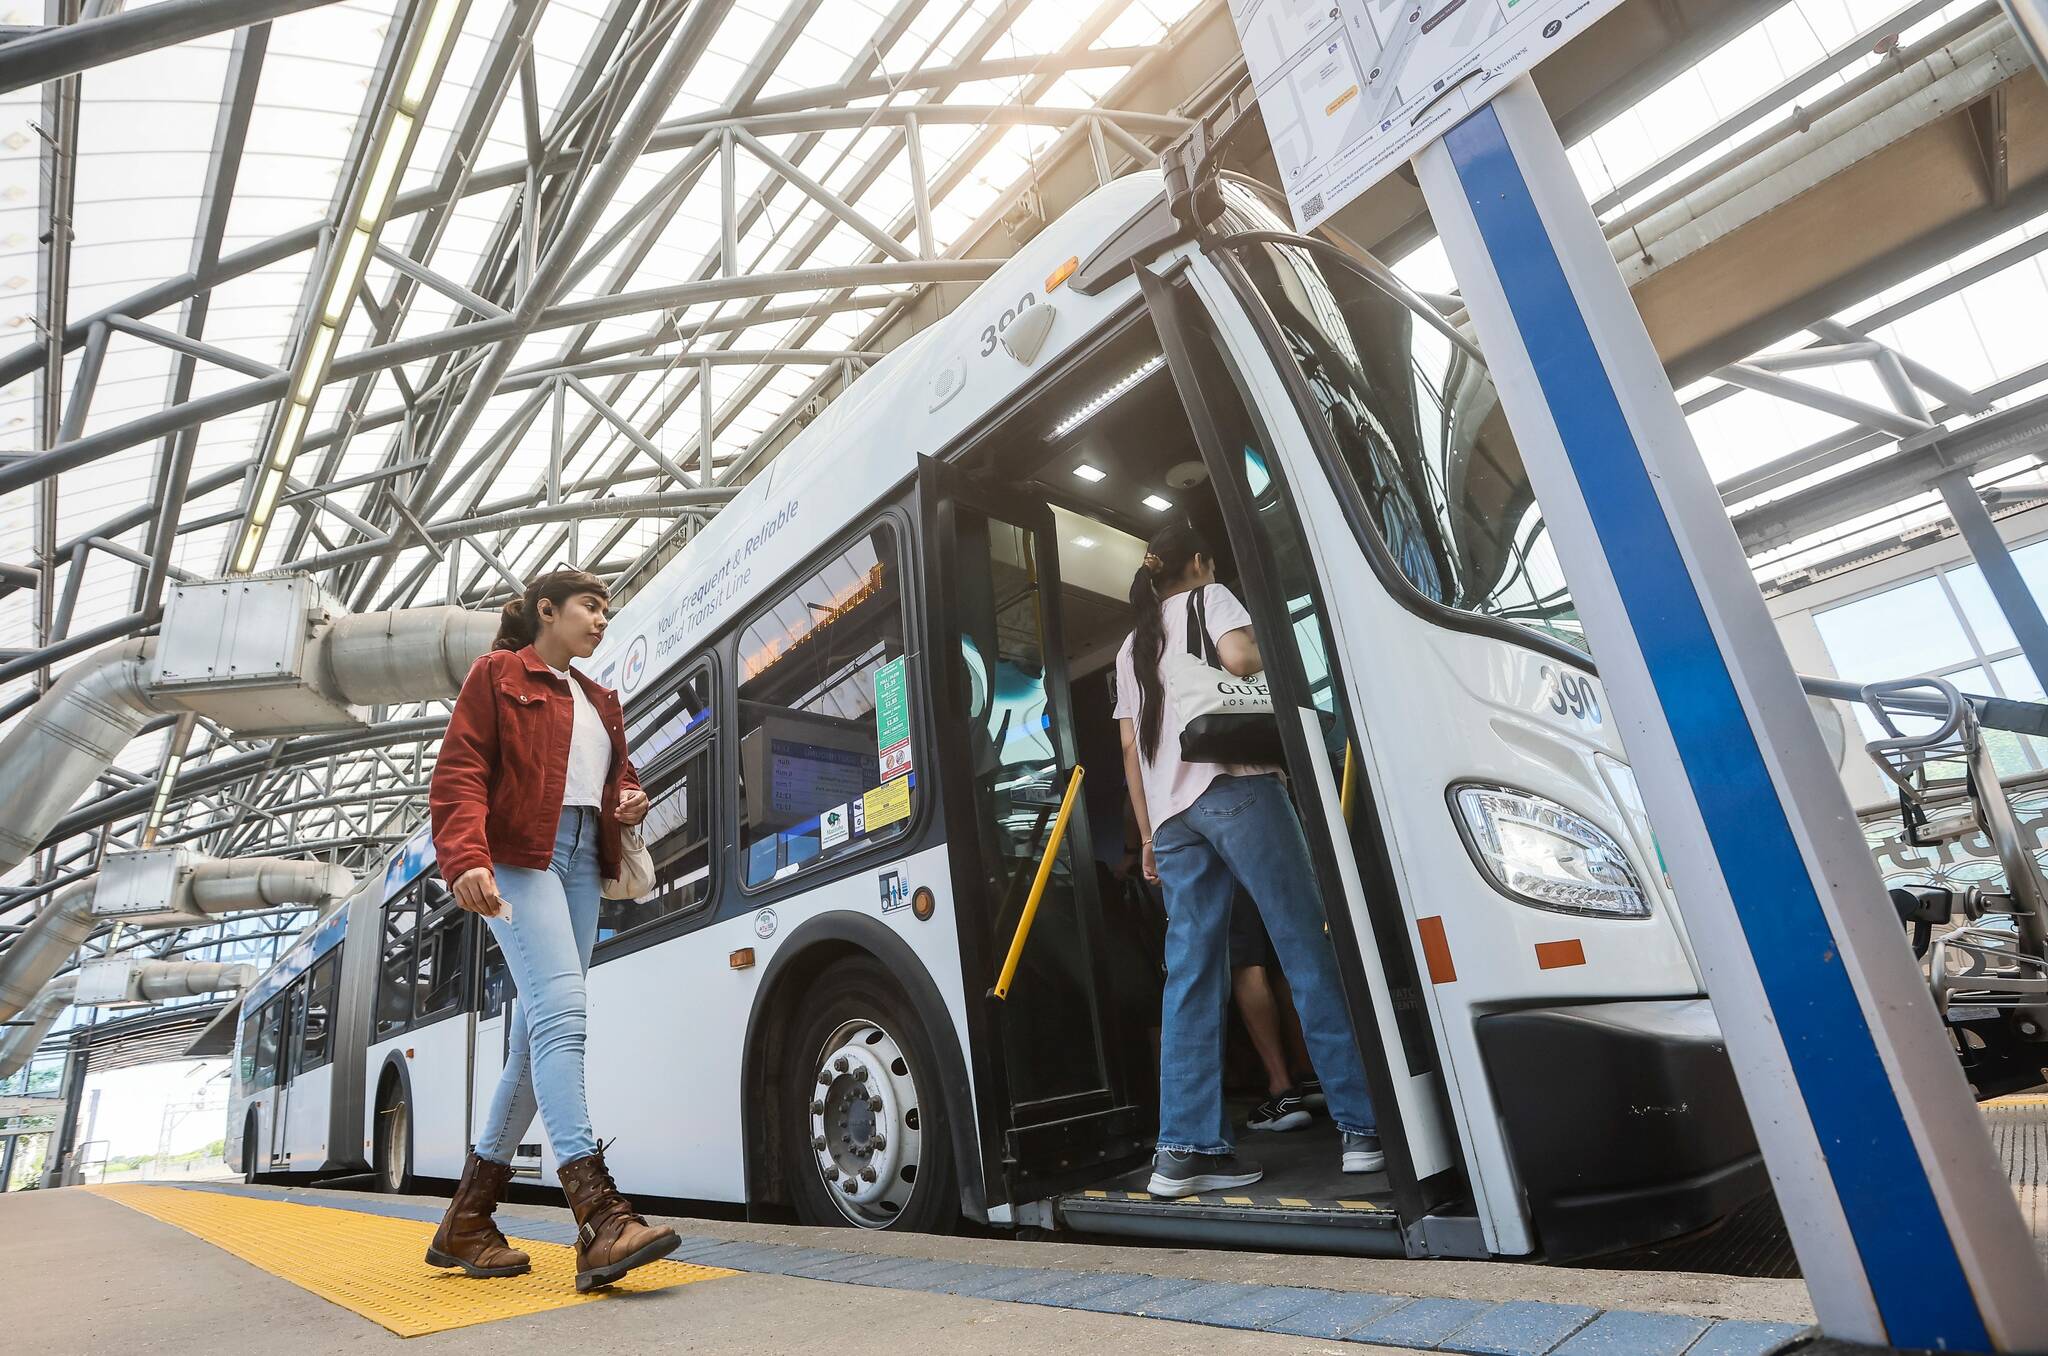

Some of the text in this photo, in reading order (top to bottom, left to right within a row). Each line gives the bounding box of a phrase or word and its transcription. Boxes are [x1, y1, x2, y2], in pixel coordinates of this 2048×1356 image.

[1493, 46, 1528, 72] Winnipeg
[656, 499, 800, 633] Your Frequent & Reliable
[655, 566, 752, 661] Rapid Transit Line
[1252, 698, 1274, 706] AN
[1540, 665, 1603, 725] 390
